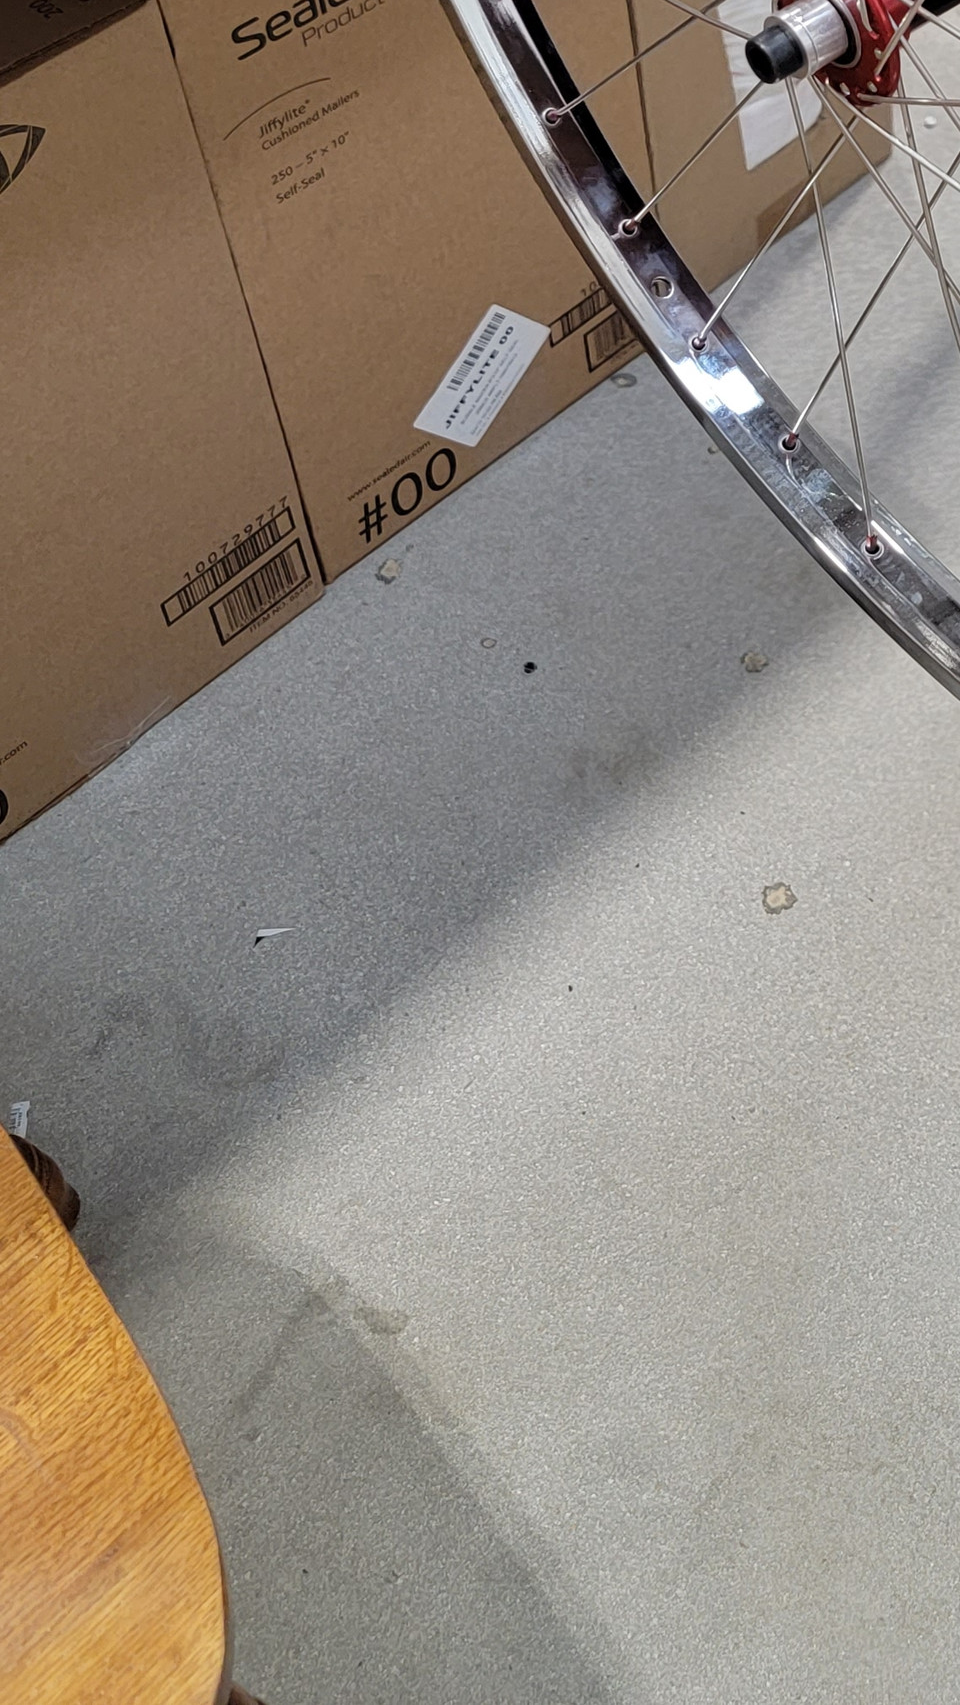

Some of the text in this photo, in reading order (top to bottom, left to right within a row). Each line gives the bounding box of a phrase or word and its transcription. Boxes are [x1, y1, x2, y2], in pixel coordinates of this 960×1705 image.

[261, 90, 360, 151] Cushioned Mailers
[271, 166, 294, 186] 250
[275, 167, 326, 204] Self-Seal
[445, 349, 499, 430] JIFFYLITE
[347, 440, 431, 502] www.sealedair.com
